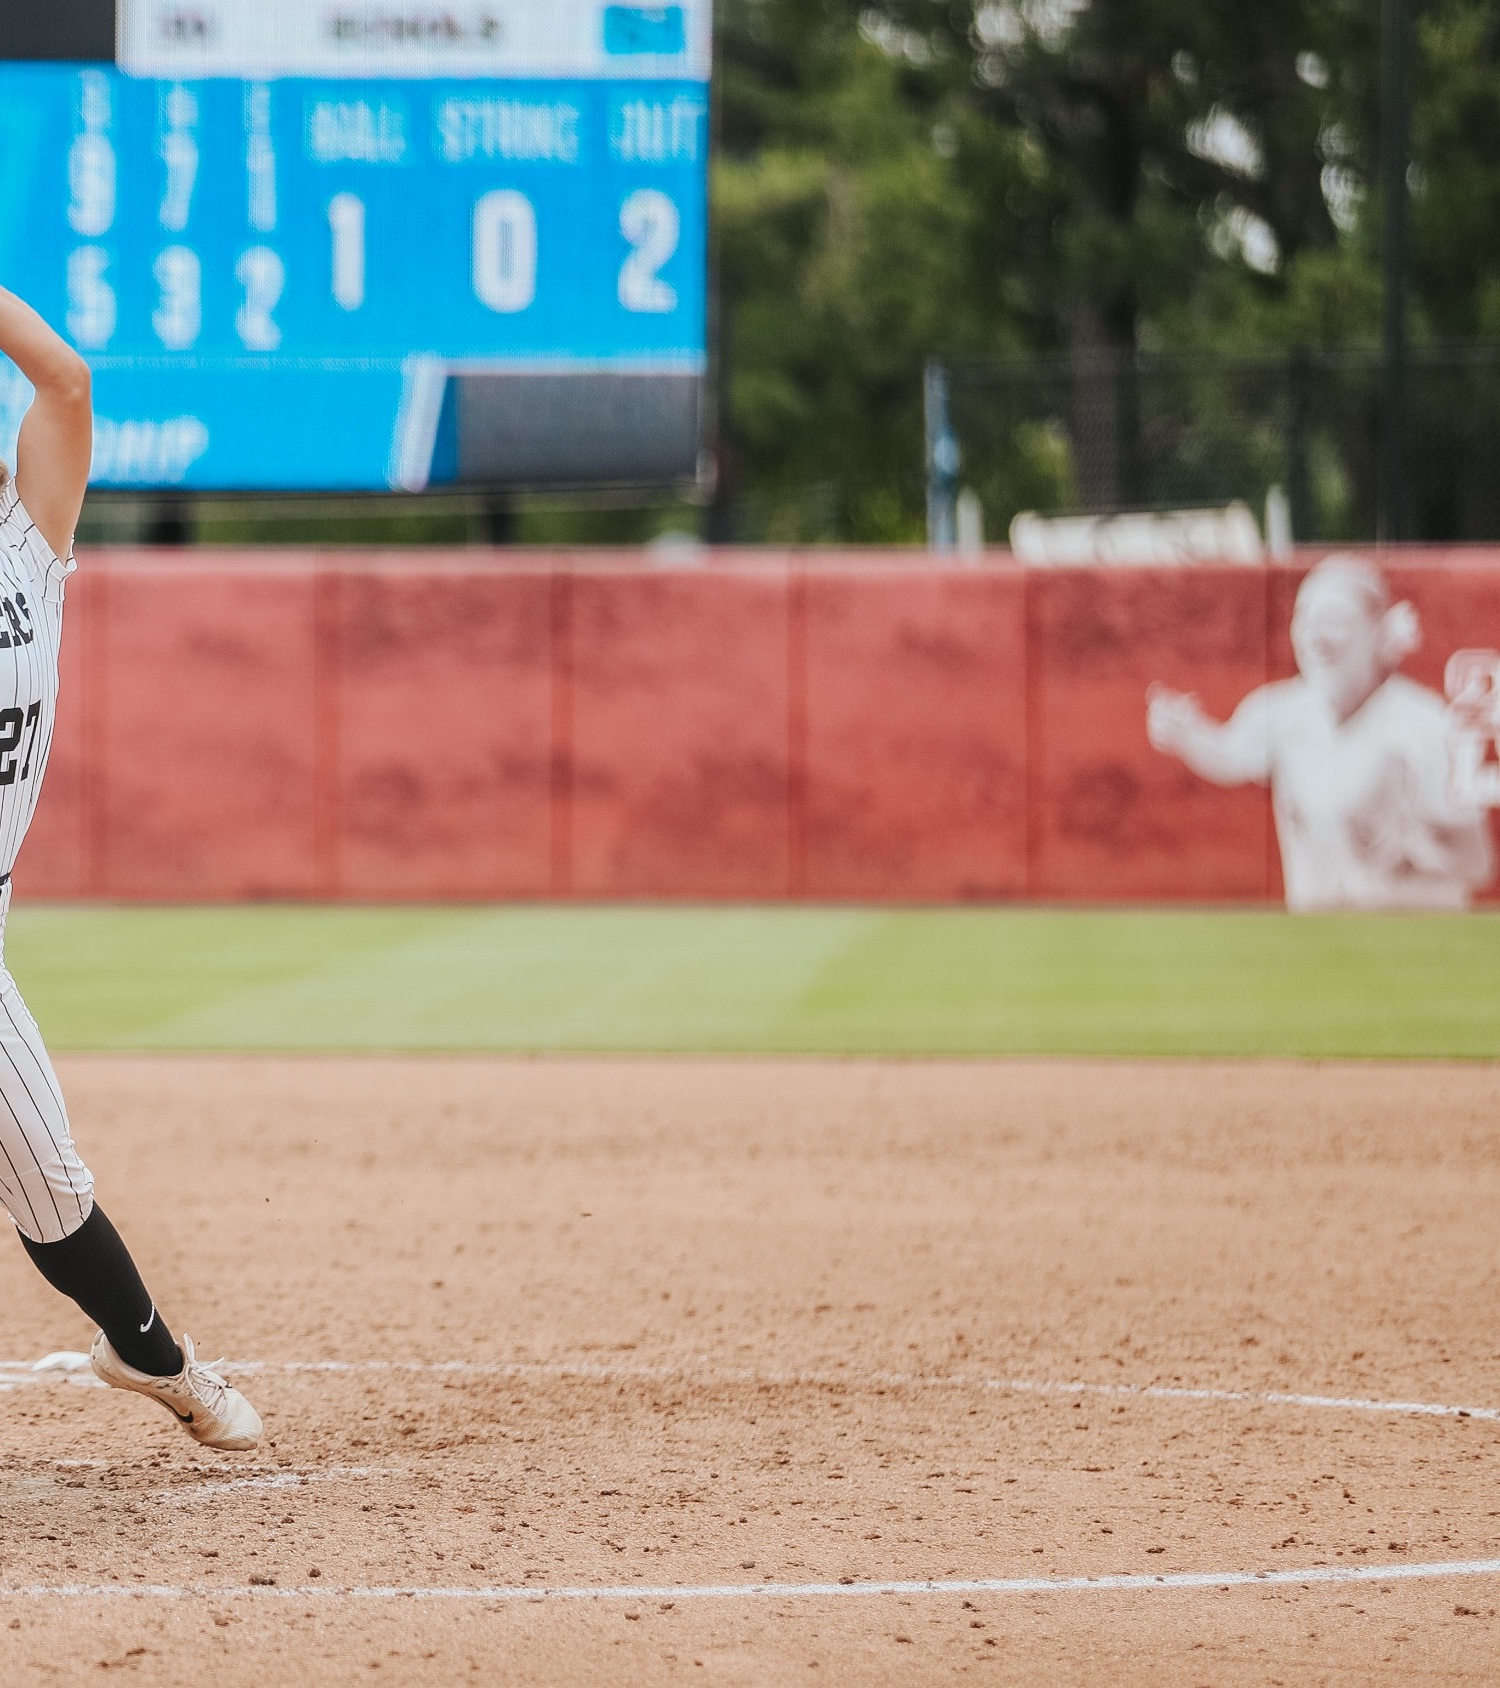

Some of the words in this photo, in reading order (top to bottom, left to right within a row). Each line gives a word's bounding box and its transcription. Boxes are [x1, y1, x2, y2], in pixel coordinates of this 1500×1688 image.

[326, 191, 367, 311] 1
[470, 188, 538, 314] 0
[617, 187, 680, 314] 2
